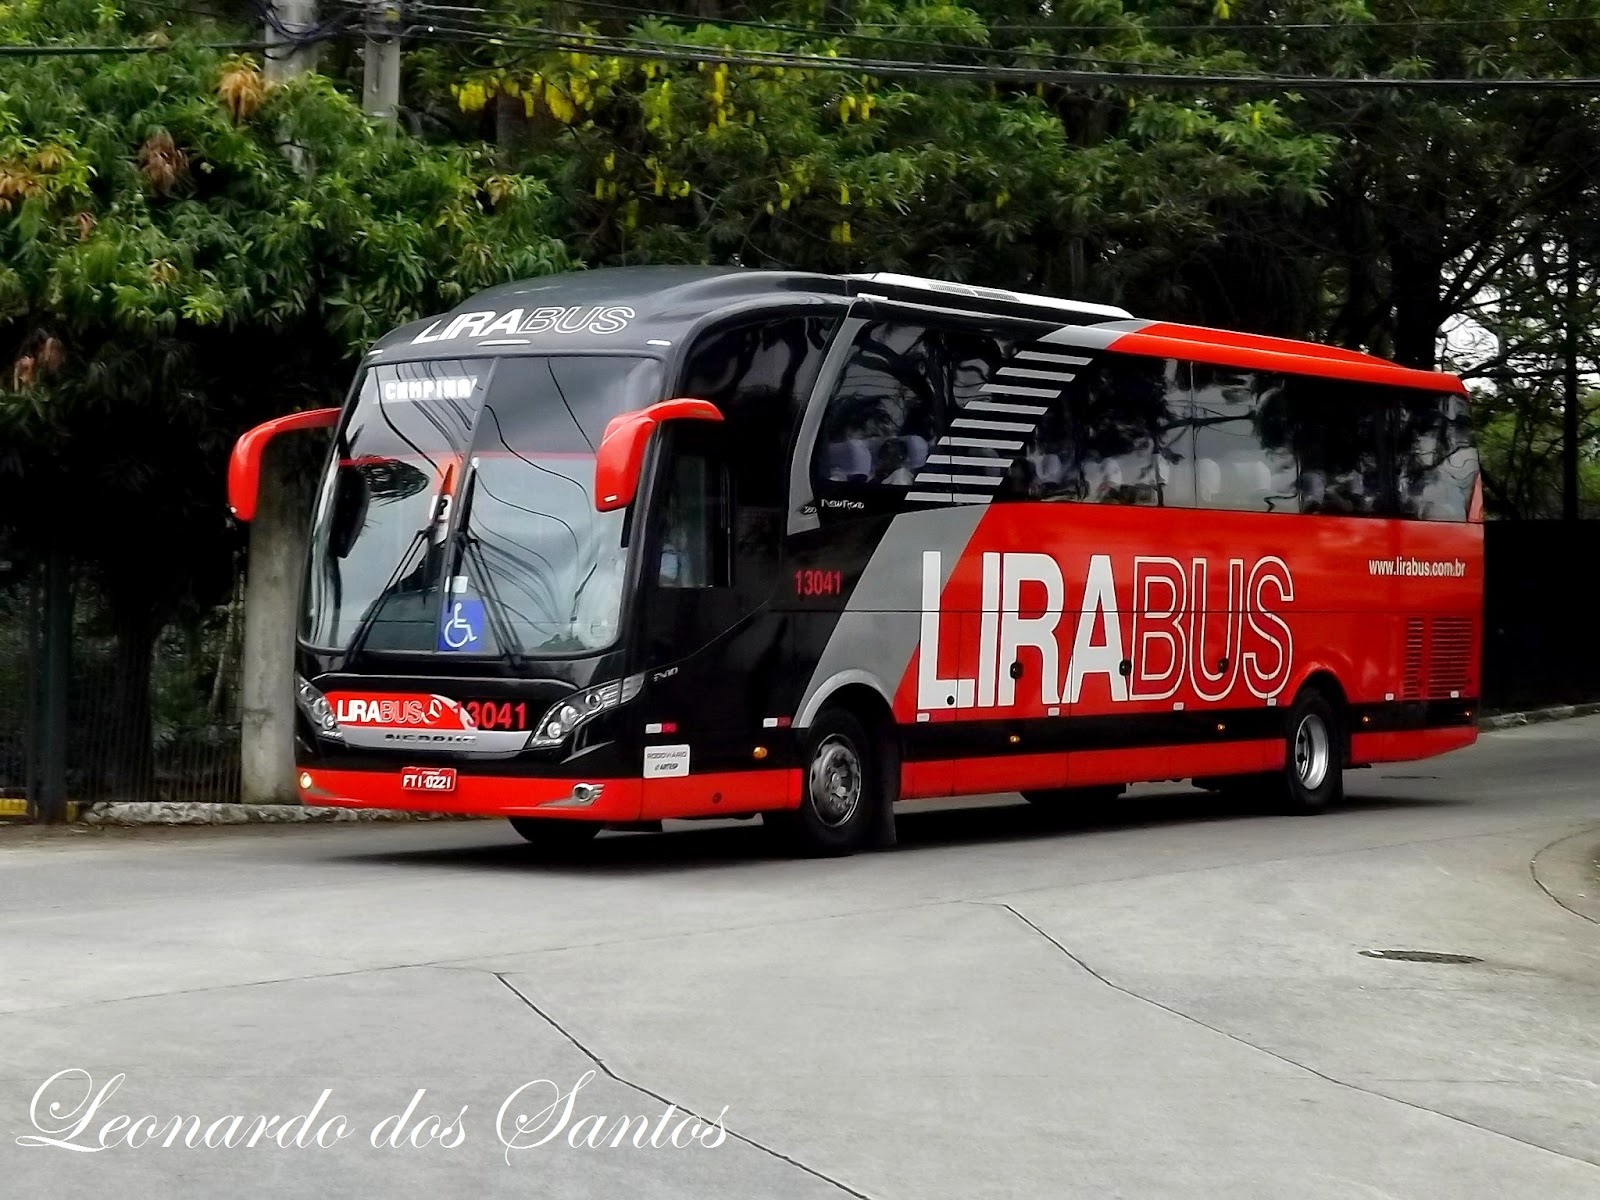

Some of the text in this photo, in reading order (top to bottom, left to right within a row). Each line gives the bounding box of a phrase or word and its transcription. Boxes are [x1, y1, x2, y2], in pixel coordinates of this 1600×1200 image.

[410, 306, 636, 345] LIRABUS
[1368, 556, 1466, 577] www.lirabus.com.br
[794, 570, 843, 596] 13041
[917, 550, 1294, 710] LIRABUS
[337, 699, 423, 724] LIRABUS
[452, 701, 526, 730] 13041
